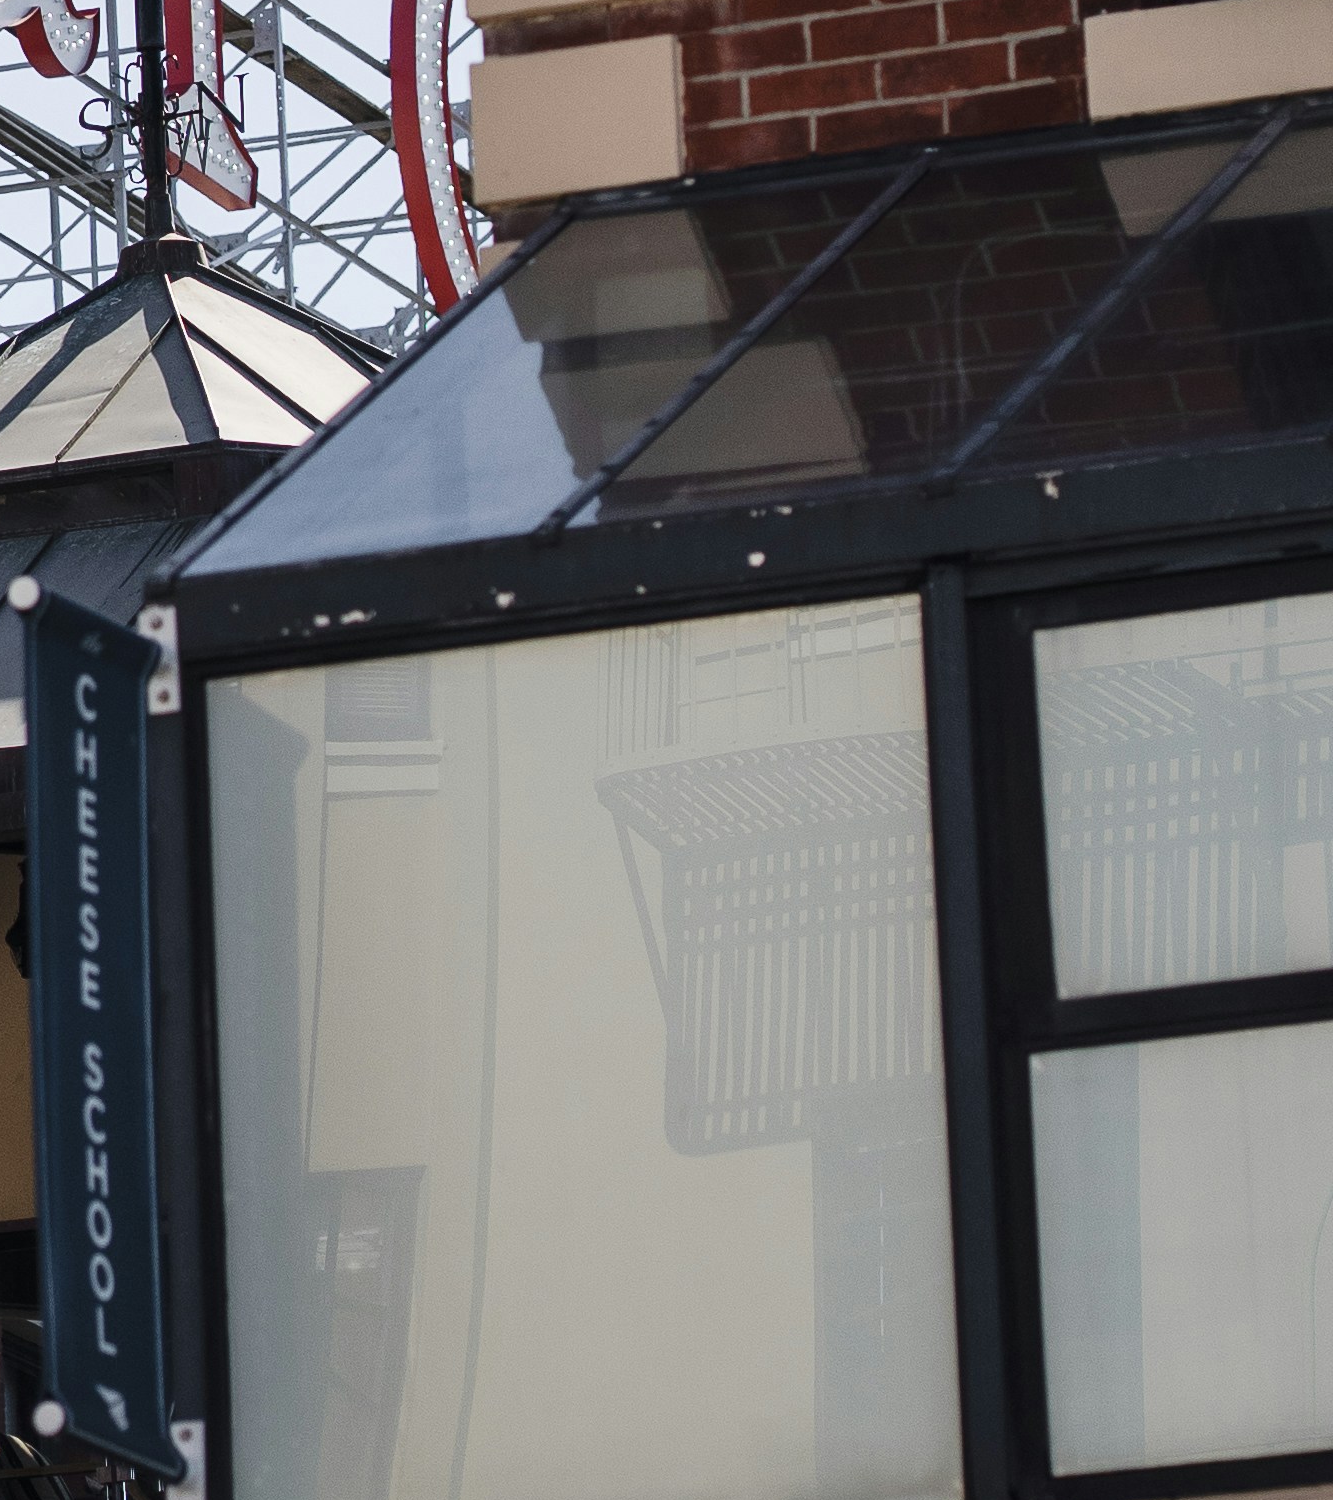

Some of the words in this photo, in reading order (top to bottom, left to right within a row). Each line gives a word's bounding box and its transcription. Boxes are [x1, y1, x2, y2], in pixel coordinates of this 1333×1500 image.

[78, 97, 114, 161] S
[193, 72, 250, 142] N
[73, 673, 101, 1012] CHEESE
[82, 1041, 117, 1358] SCHOOL
